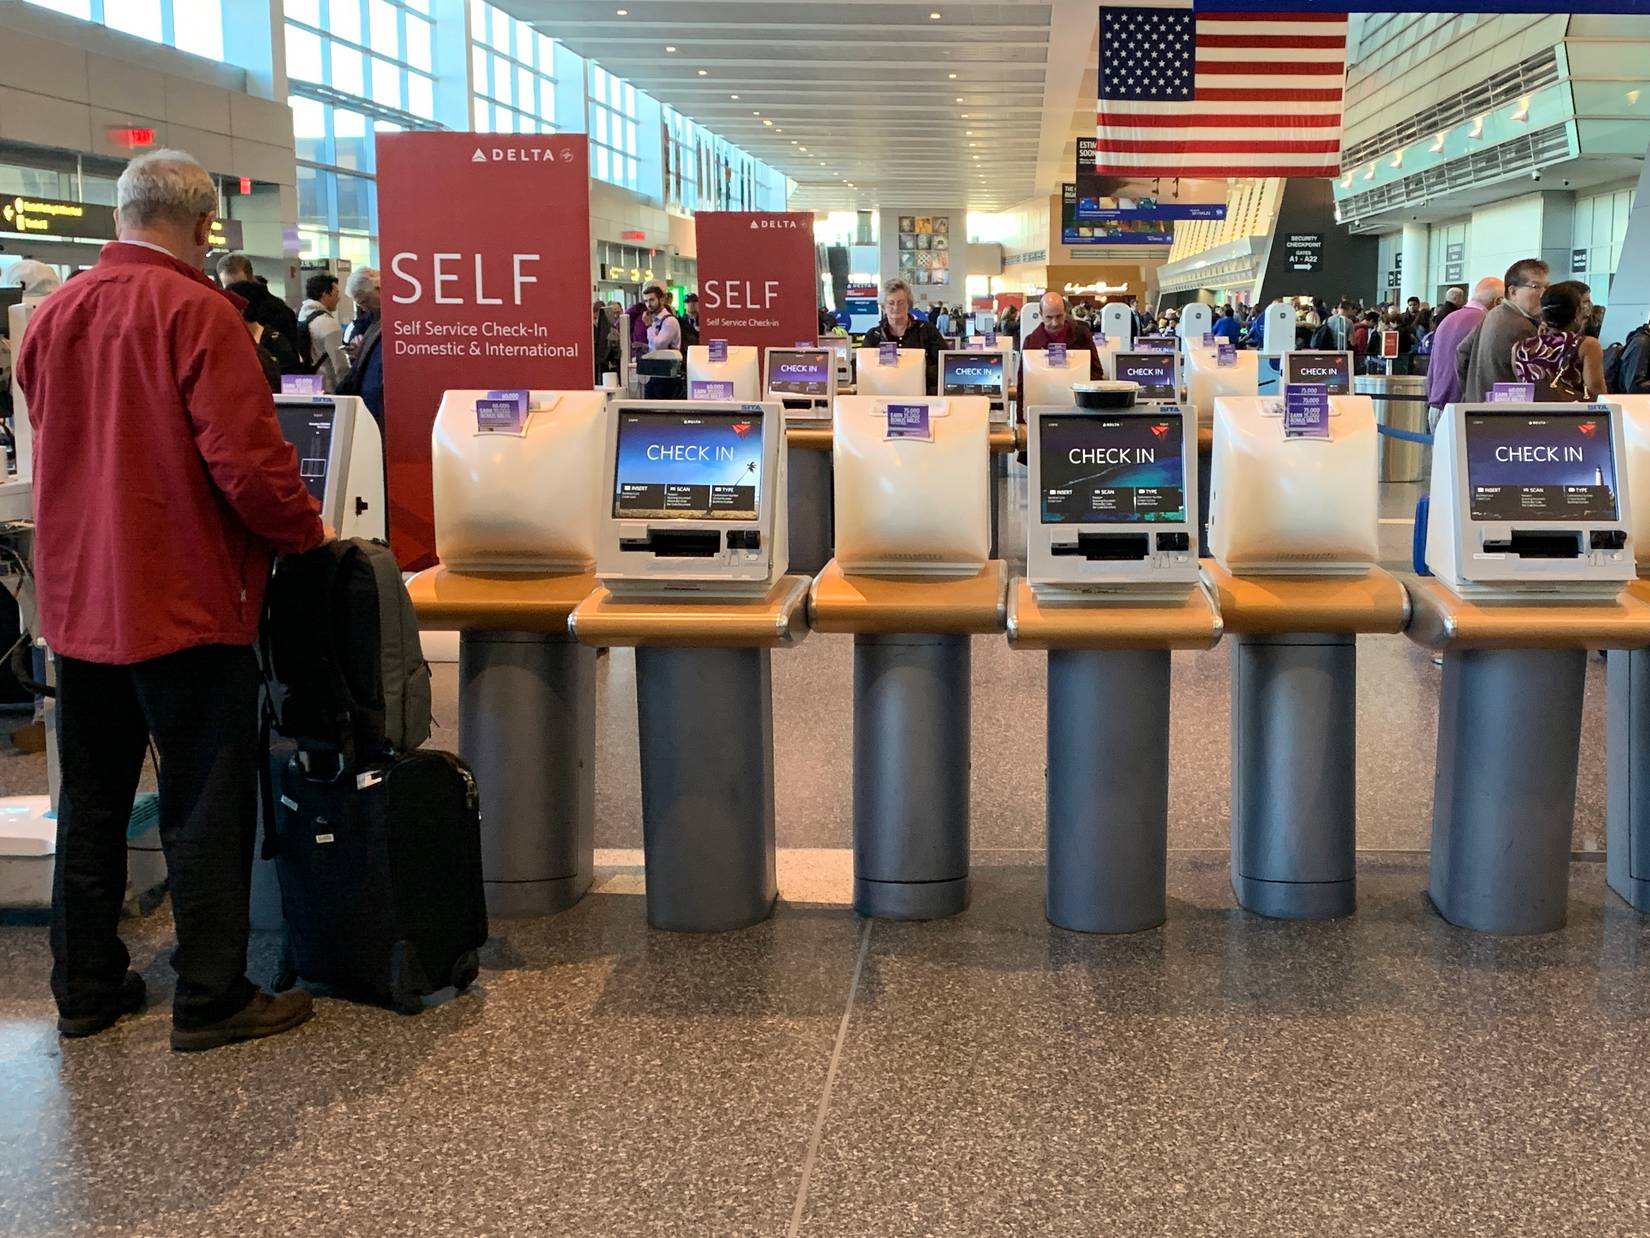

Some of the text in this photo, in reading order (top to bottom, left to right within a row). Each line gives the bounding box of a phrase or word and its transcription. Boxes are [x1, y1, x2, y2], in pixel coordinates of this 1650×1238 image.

[492, 148, 555, 161] DELTA
[761, 220, 797, 229] DELTA
[391, 252, 541, 305] SELF
[704, 280, 779, 309] SELF
[393, 320, 548, 337] Self Service Check-In
[706, 318, 780, 327] Self Service Check-in
[394, 340, 579, 358] Domestic & International
[780, 364, 818, 373] CHECK IN
[955, 367, 992, 376] CHECK IN
[1127, 367, 1164, 376] CHECK IN
[1300, 367, 1338, 376] CHECK IN
[646, 444, 734, 462] CHECK IN
[1068, 448, 1155, 465] CHECK IN
[1495, 446, 1583, 463] CHECK IN
